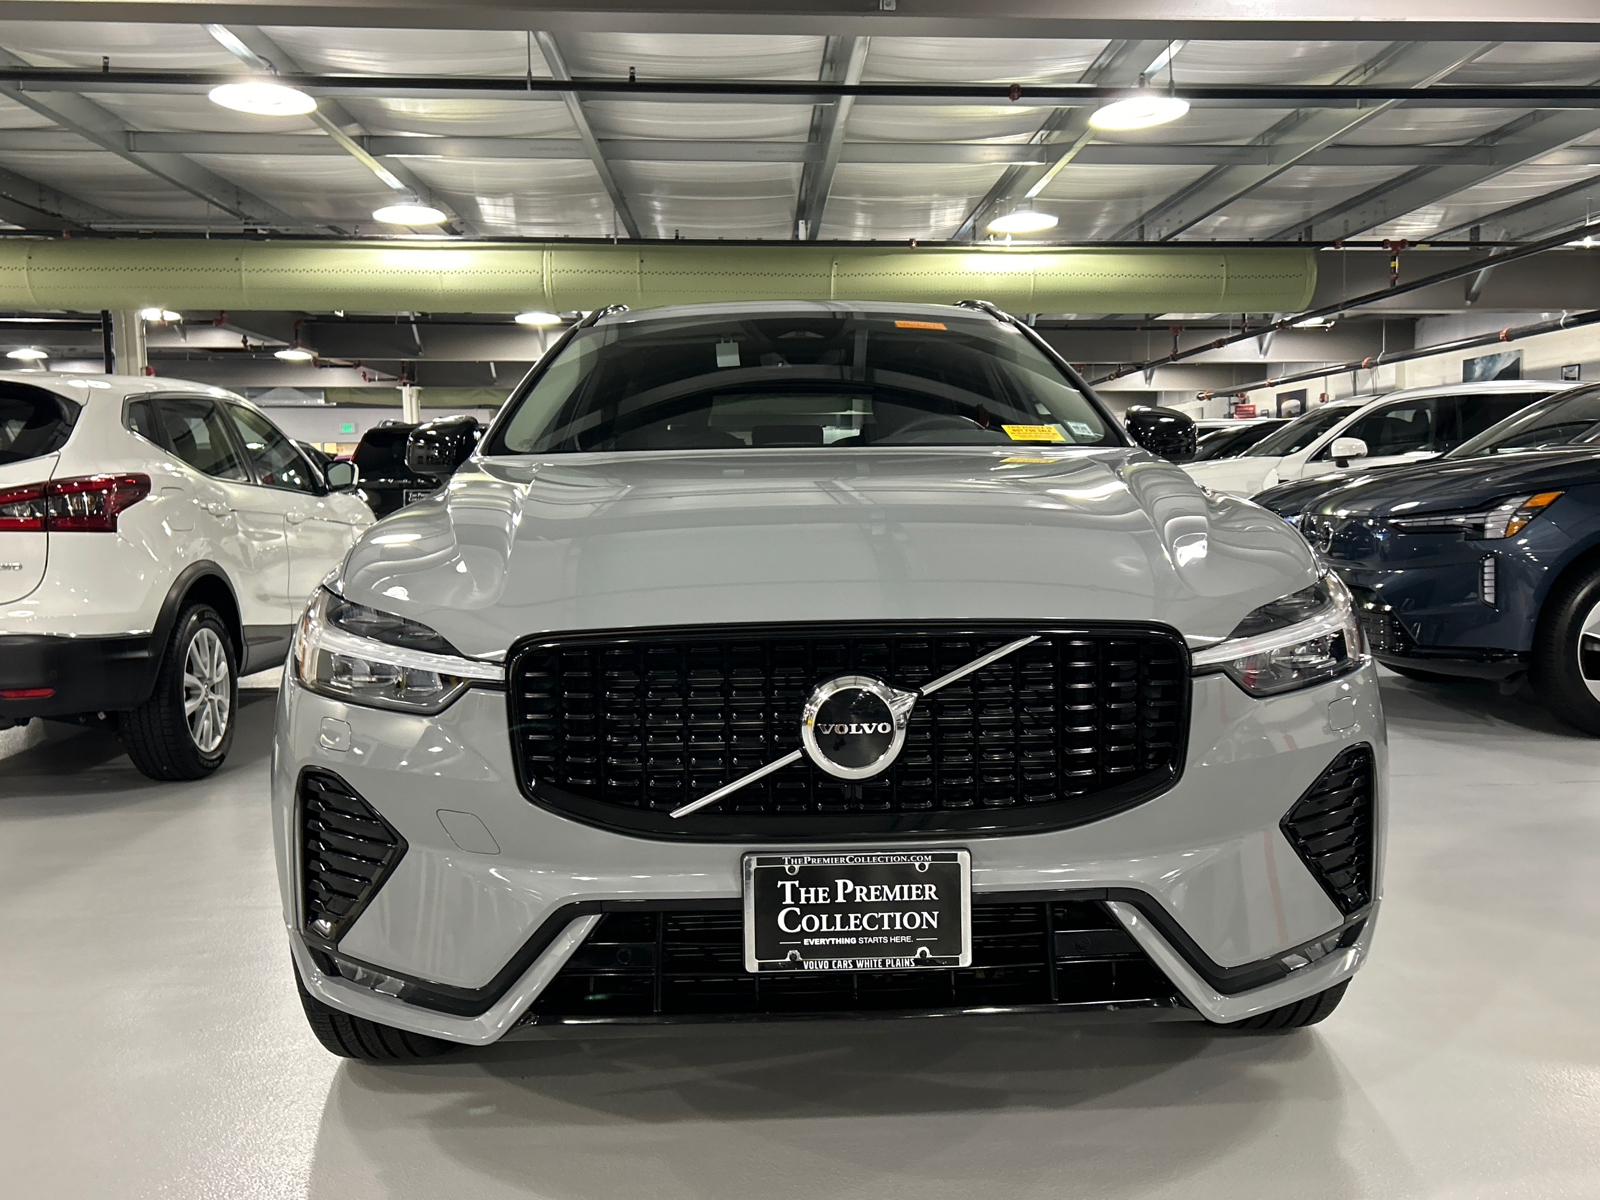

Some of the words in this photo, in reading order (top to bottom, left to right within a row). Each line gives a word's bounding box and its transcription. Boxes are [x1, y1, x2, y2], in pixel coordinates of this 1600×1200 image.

[817, 722, 892, 735] VOLVO
[777, 880, 830, 905] THE
[835, 879, 939, 903] PREMIER
[777, 907, 939, 933] COLLECTION
[803, 938, 857, 946] EVERYTHING
[803, 960, 829, 970] VOLVO
[832, 960, 853, 969] CARS
[856, 959, 882, 968] WHITE
[885, 958, 915, 968] PLAINS
